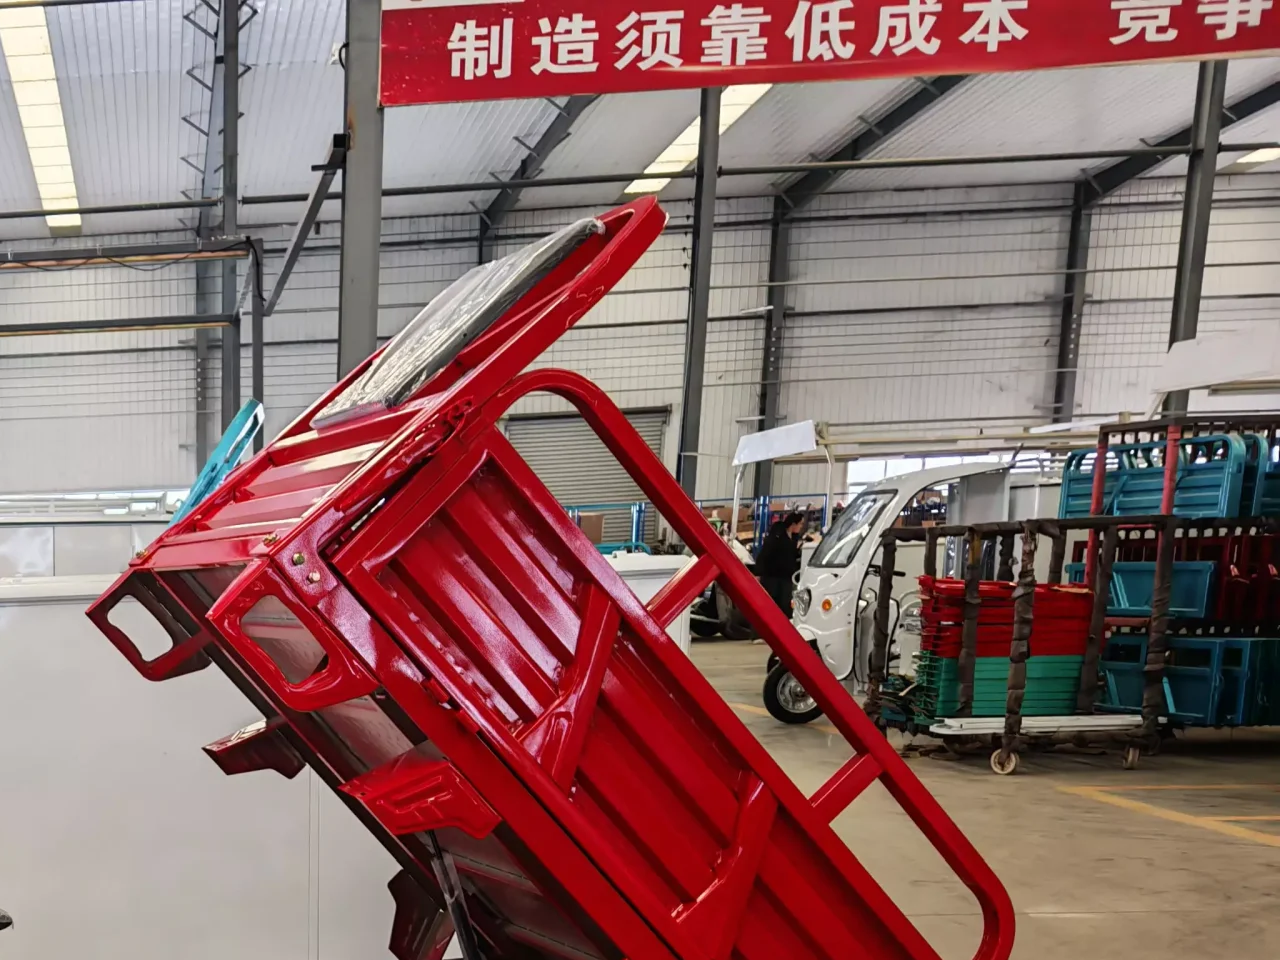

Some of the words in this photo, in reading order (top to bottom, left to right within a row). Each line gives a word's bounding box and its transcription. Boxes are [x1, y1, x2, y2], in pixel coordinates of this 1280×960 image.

[447, 0, 1029, 80] 制造须靠低成本
[1109, 0, 1273, 45] 竞争
